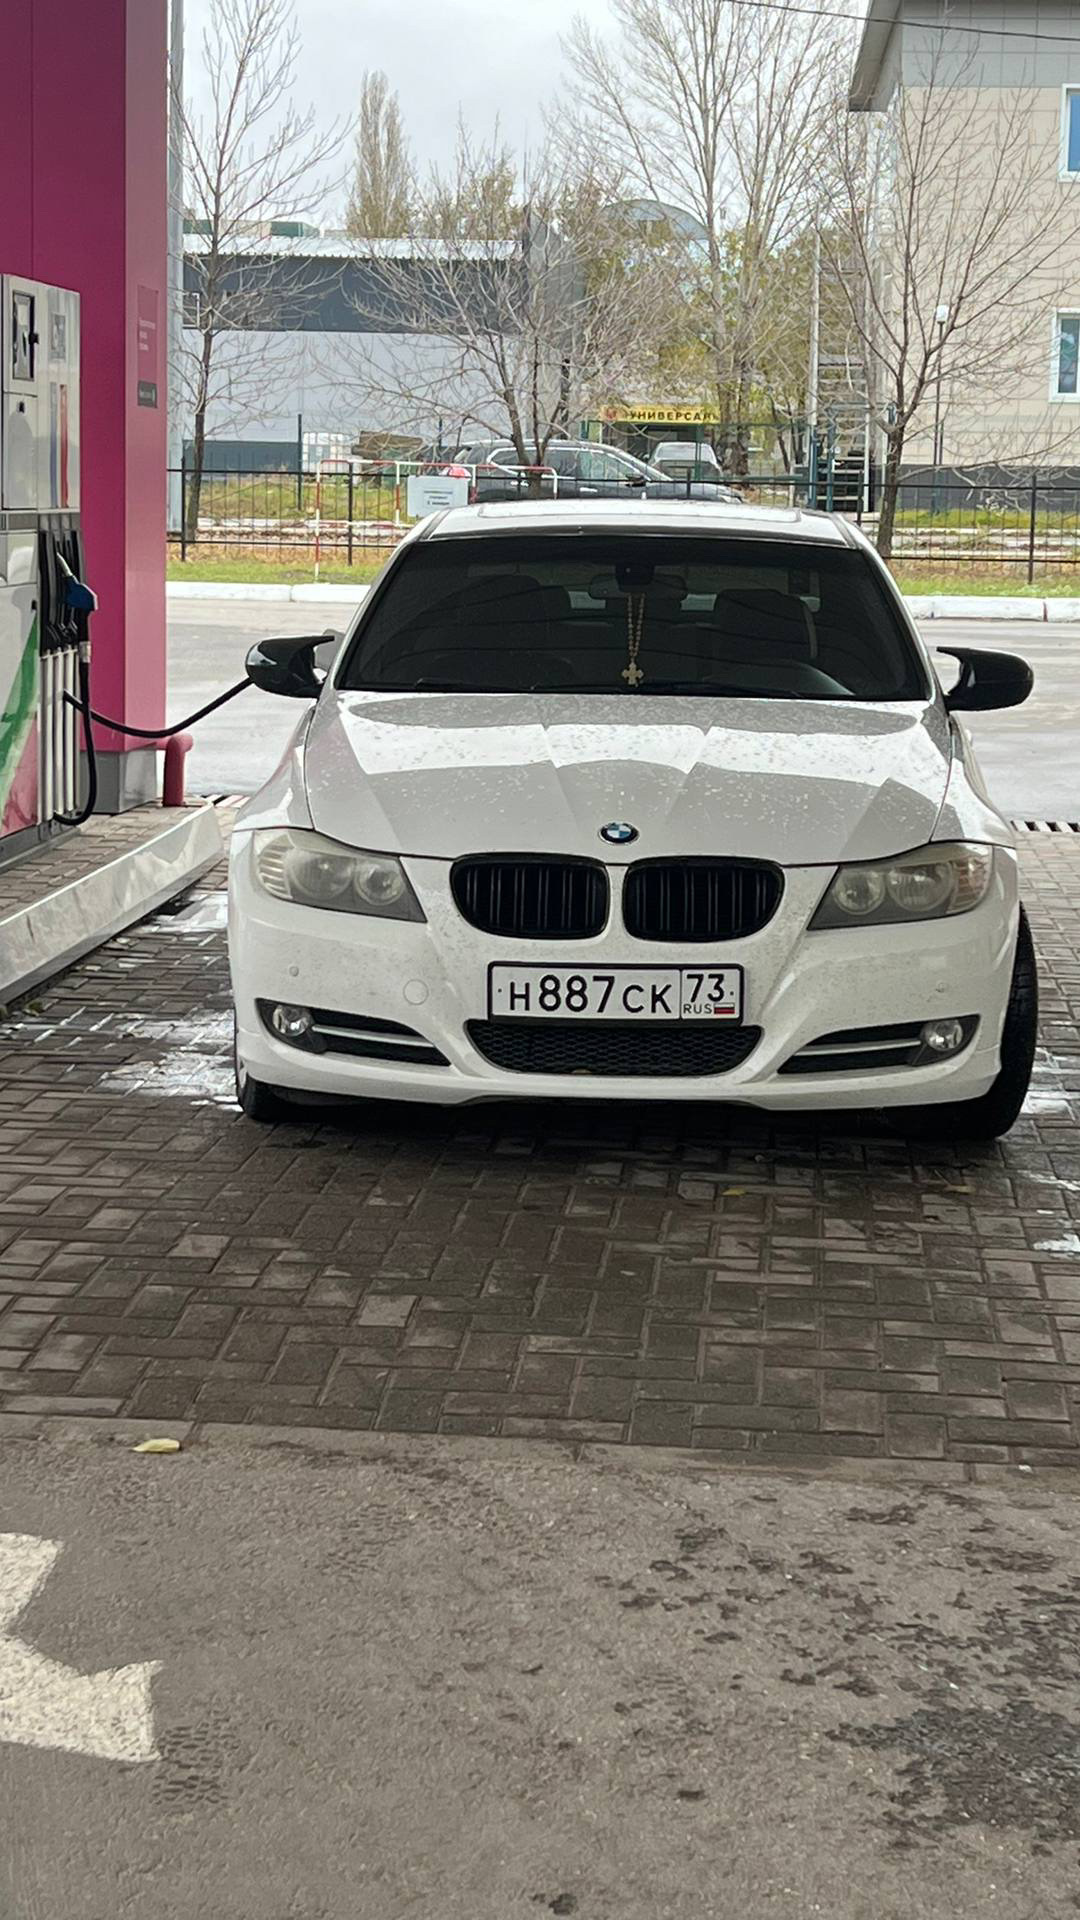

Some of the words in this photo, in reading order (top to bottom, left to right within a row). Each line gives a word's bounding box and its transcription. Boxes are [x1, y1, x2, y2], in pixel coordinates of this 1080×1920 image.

[509, 974, 673, 1014] Н887СК
[686, 973, 725, 1002] 73
[683, 1004, 713, 1015] RUS
